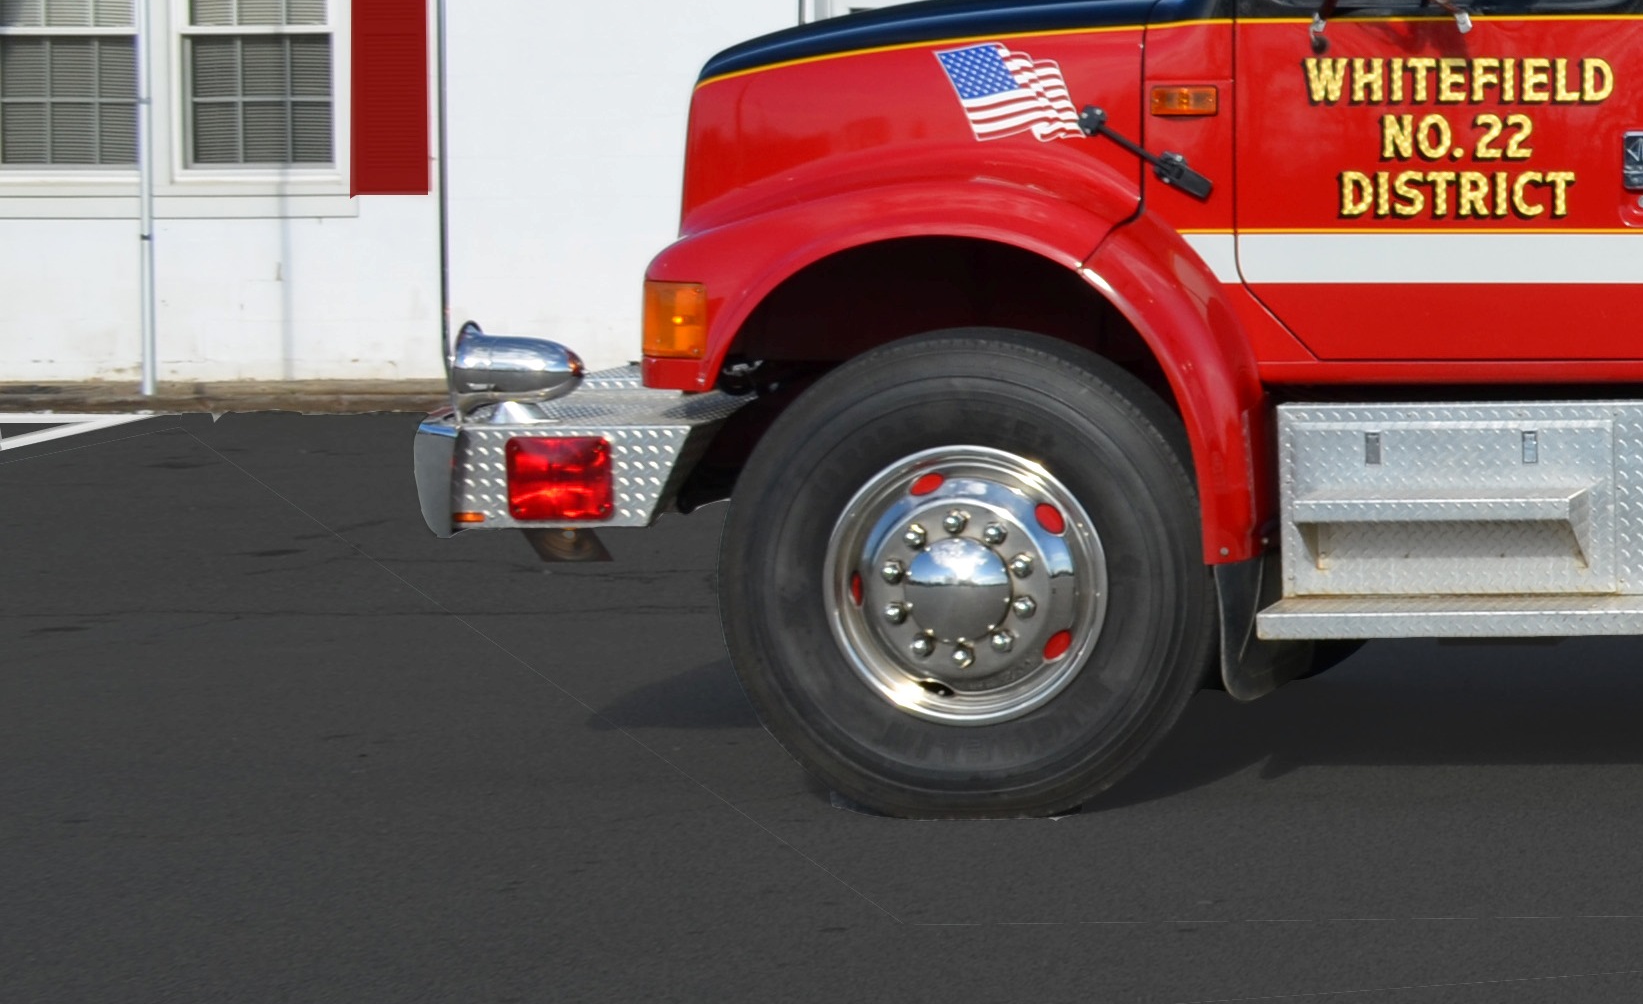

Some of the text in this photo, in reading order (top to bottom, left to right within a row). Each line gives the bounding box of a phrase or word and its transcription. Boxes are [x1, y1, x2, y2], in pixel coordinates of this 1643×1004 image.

[1302, 56, 1615, 105] WHITEFIELD
[1381, 112, 1534, 161] NO. 22
[1339, 169, 1577, 218] DISTRICT
